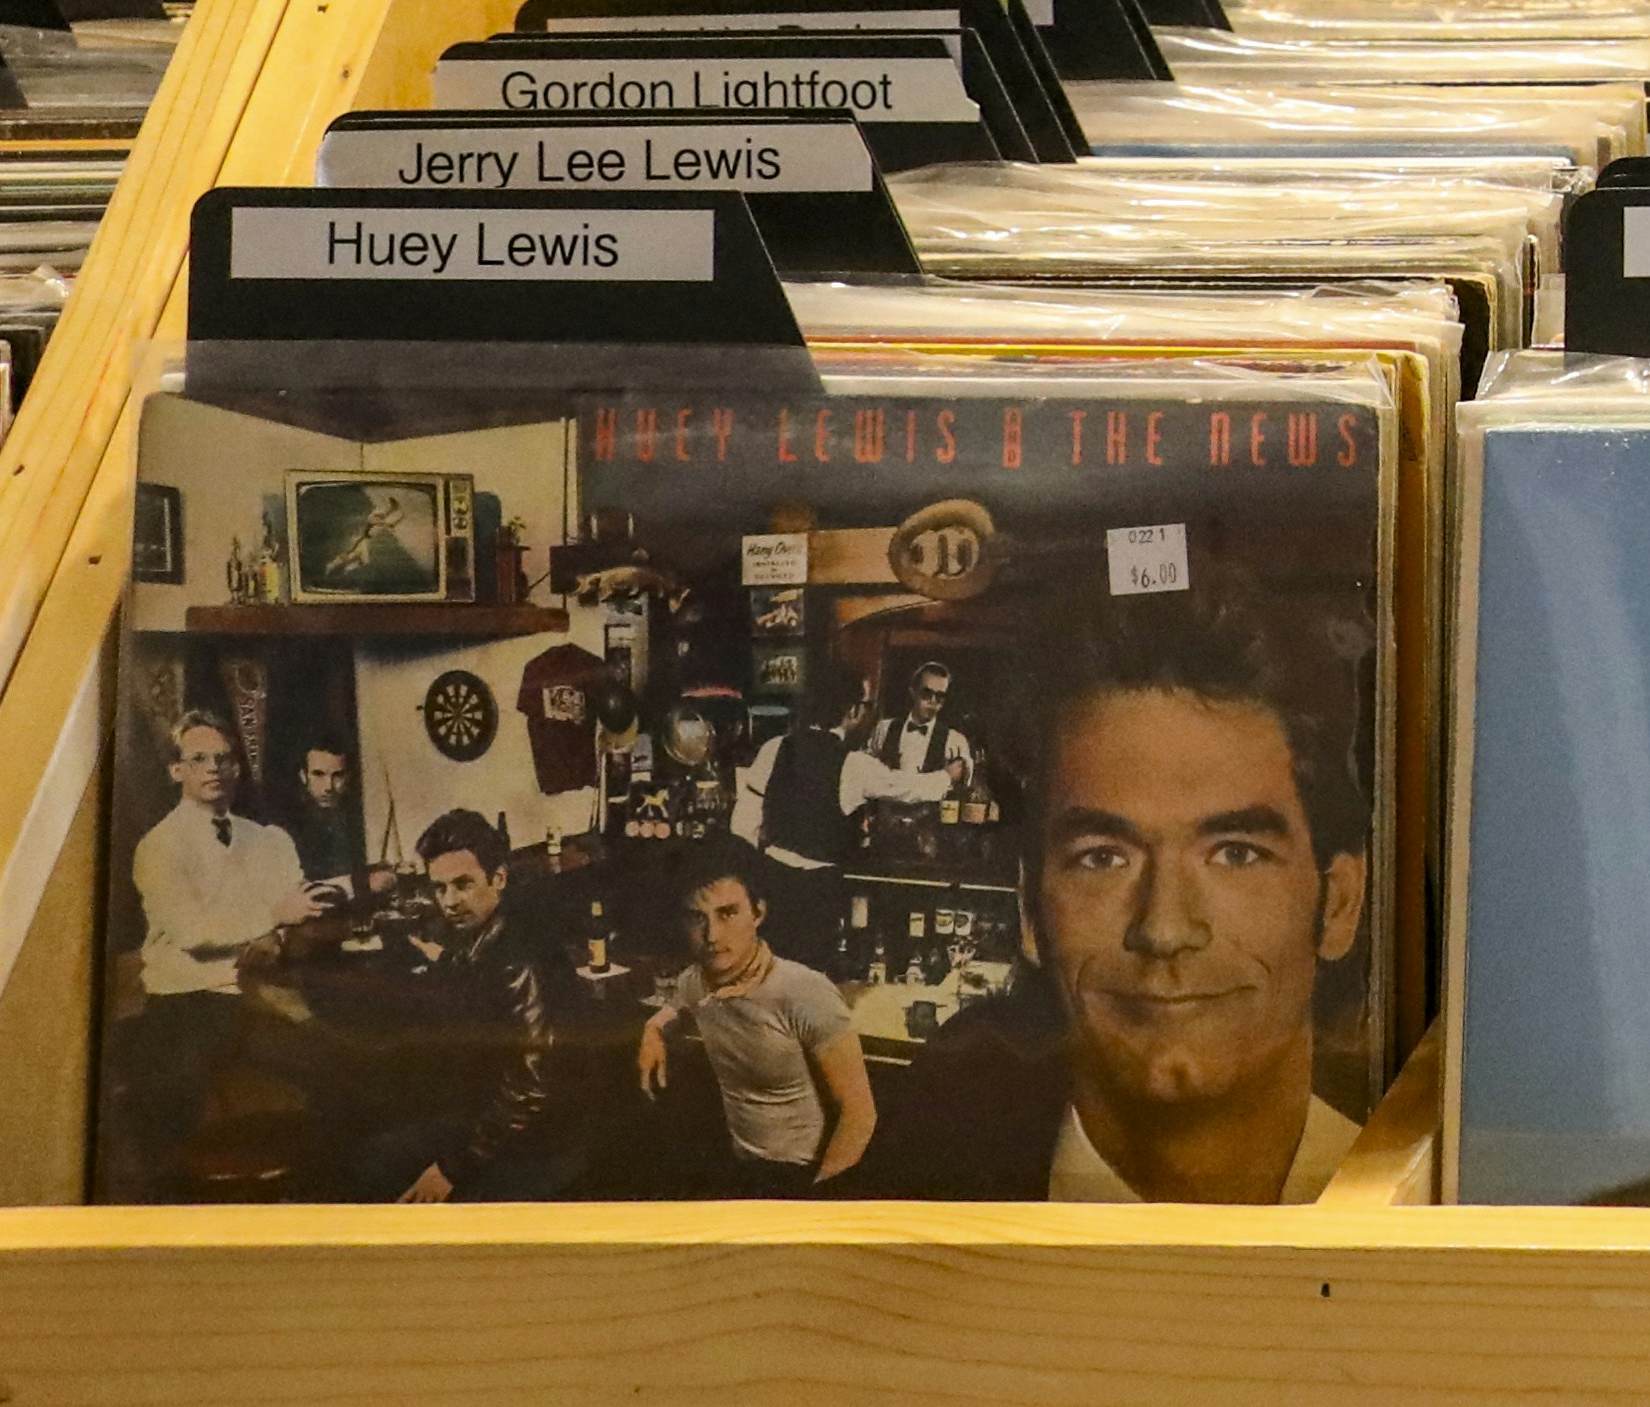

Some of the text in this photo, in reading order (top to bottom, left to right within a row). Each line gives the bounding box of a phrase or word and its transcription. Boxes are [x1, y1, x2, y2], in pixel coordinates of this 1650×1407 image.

[501, 70, 676, 111] Gordon
[399, 137, 783, 188] Jerry Lee Lewis
[327, 221, 620, 274] Huey Lewis
[592, 408, 1360, 469] HUEY LEWIS THE NEWS
[1130, 562, 1178, 588] $6.00
